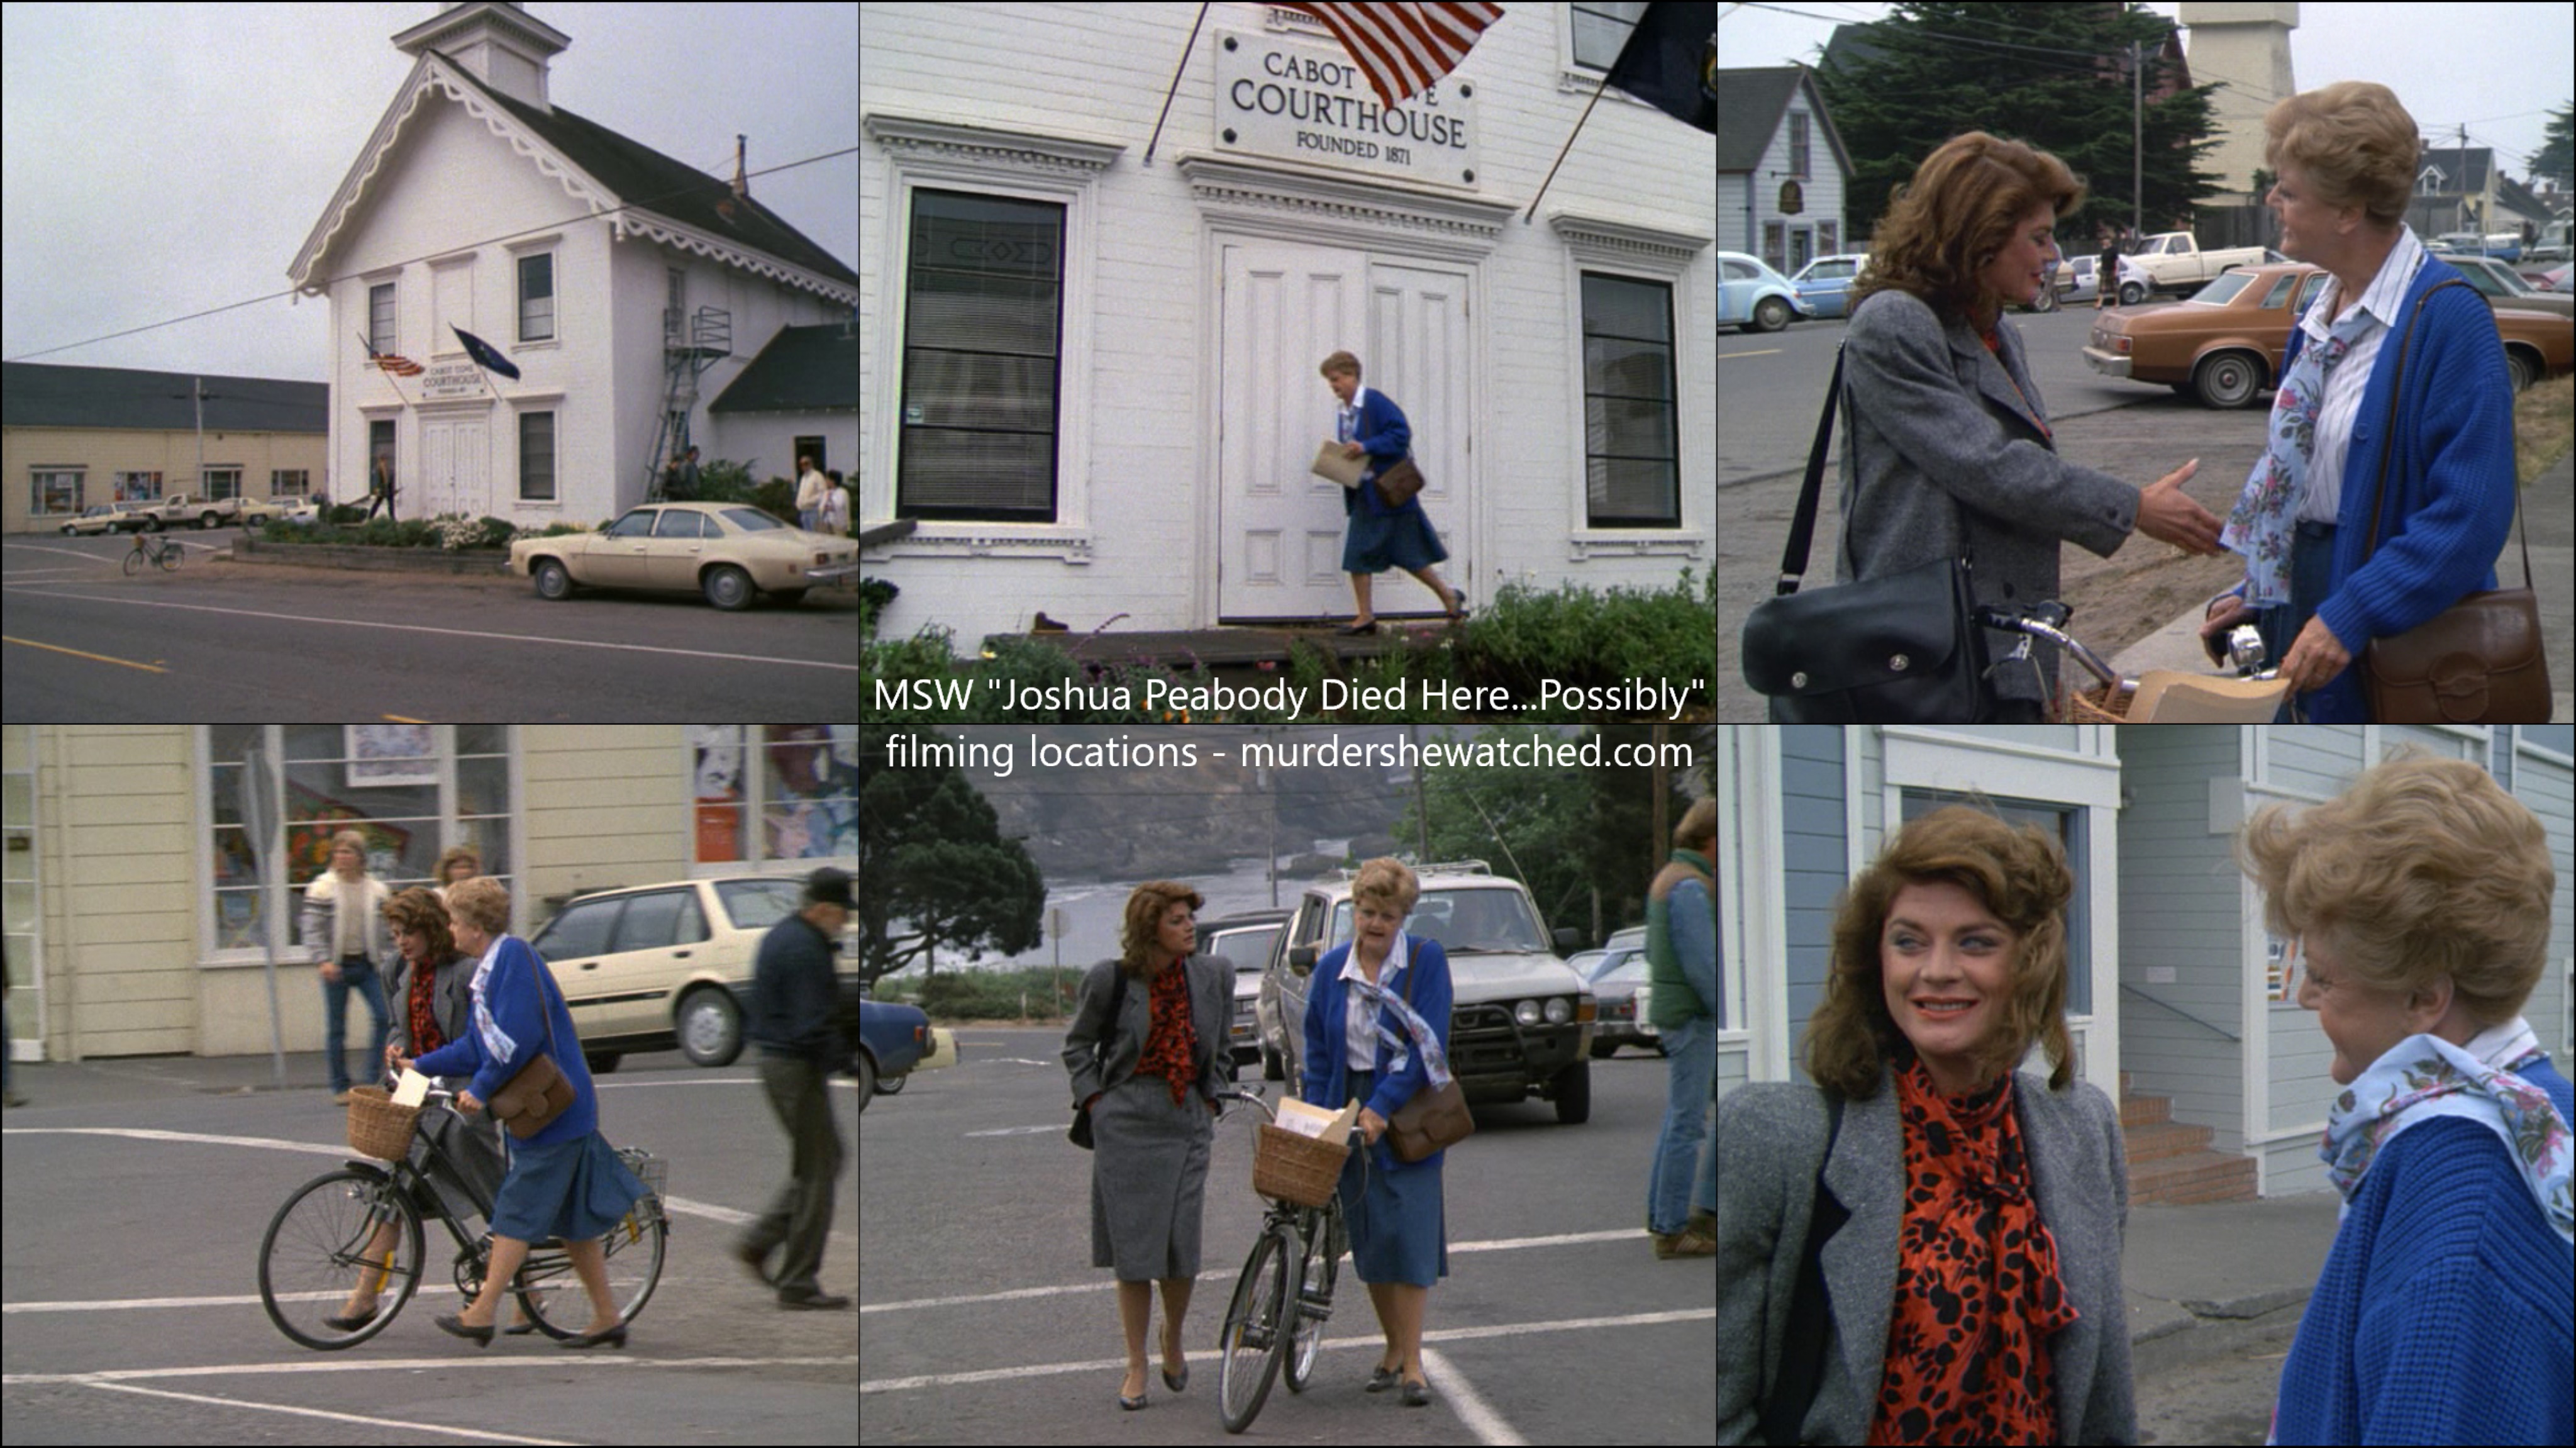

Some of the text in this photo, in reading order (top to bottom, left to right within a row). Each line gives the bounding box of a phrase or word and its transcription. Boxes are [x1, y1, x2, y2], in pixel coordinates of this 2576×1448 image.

[1264, 52, 1356, 89] CABOT
[1231, 79, 1467, 149] COURTHOUSE
[1297, 131, 1411, 165] FOUNDED 1871
